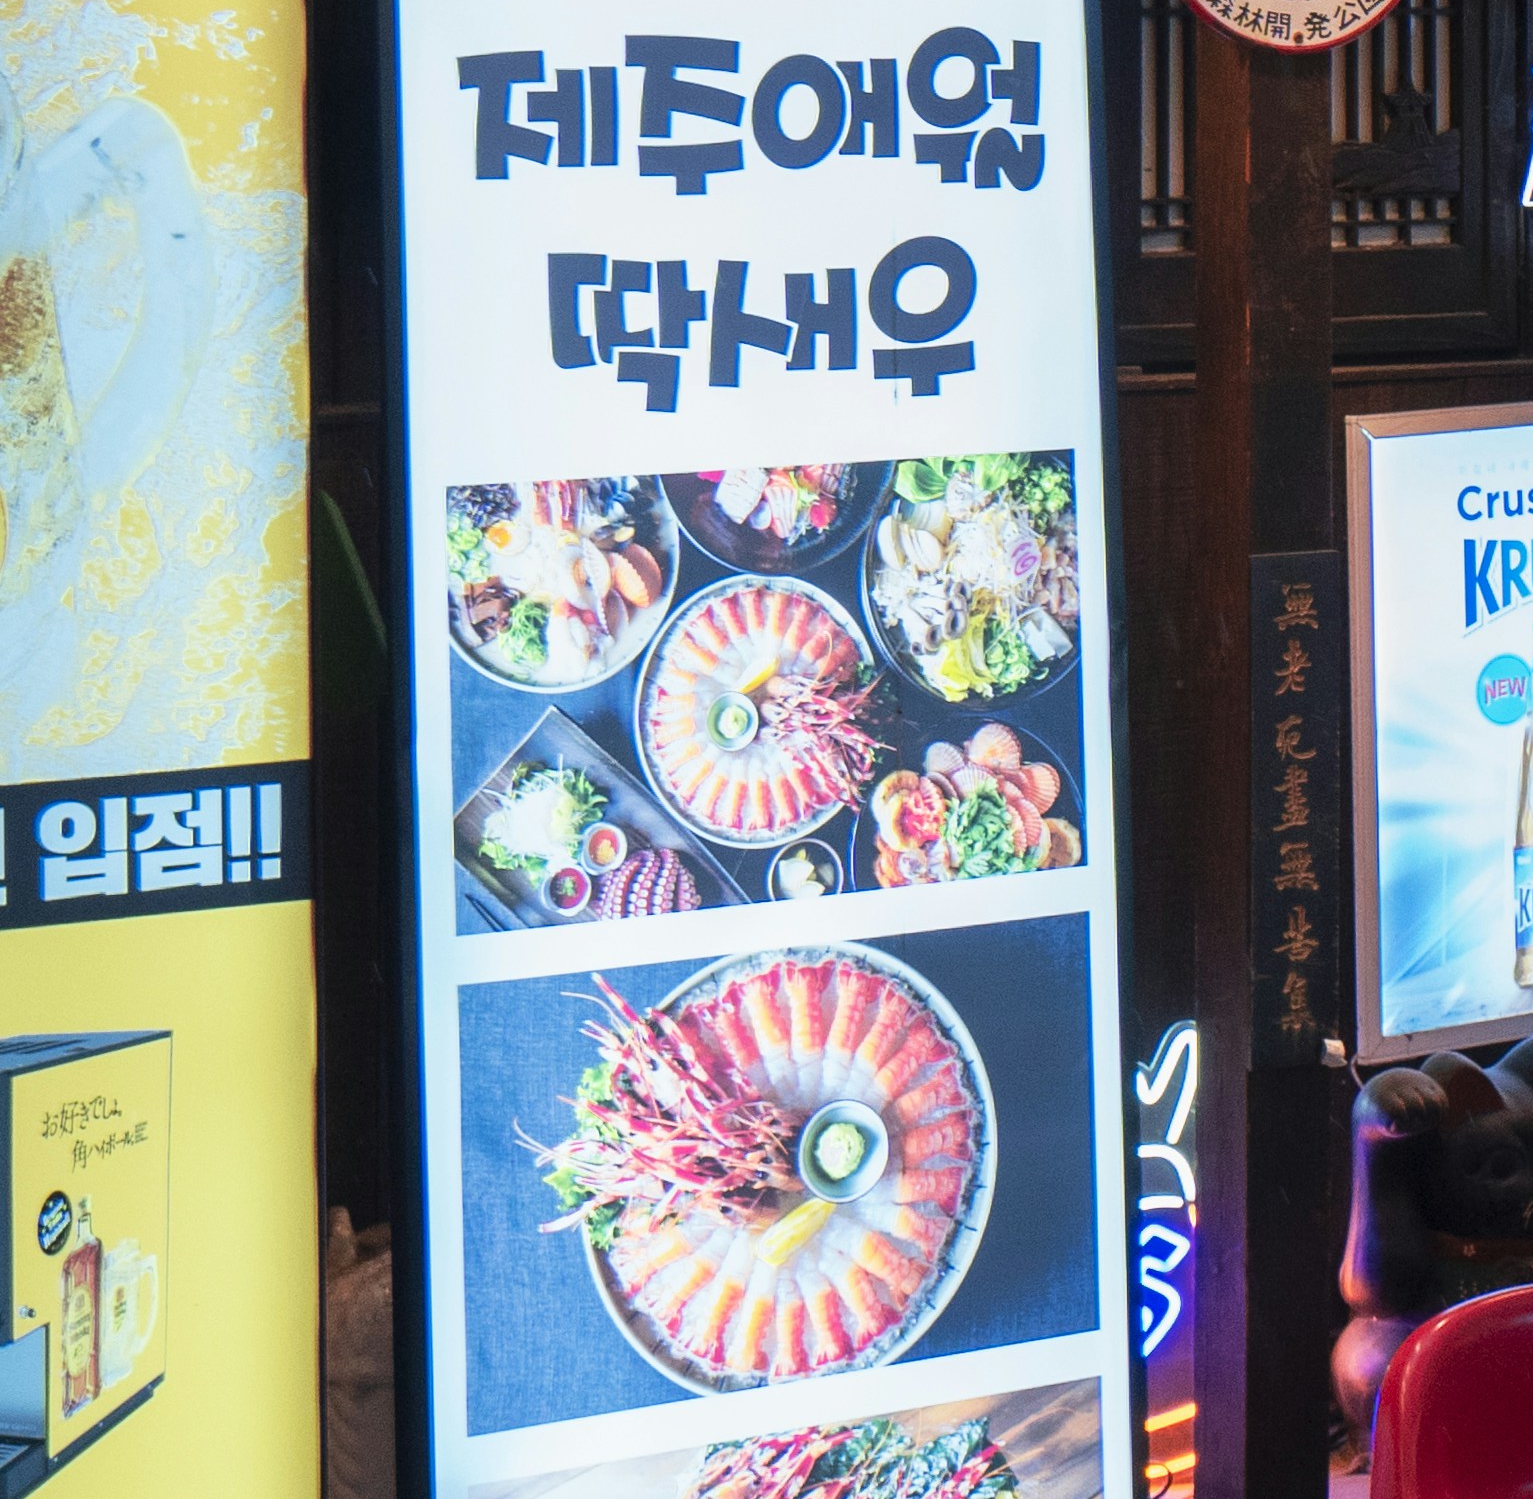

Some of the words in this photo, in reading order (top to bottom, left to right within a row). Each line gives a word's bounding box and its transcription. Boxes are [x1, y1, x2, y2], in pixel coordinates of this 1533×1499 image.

[456, 26, 1046, 196] 제주애월
[547, 235, 978, 414] 딱새우
[1483, 675, 1528, 705] NEW
[36, 781, 283, 901] 입점!!
